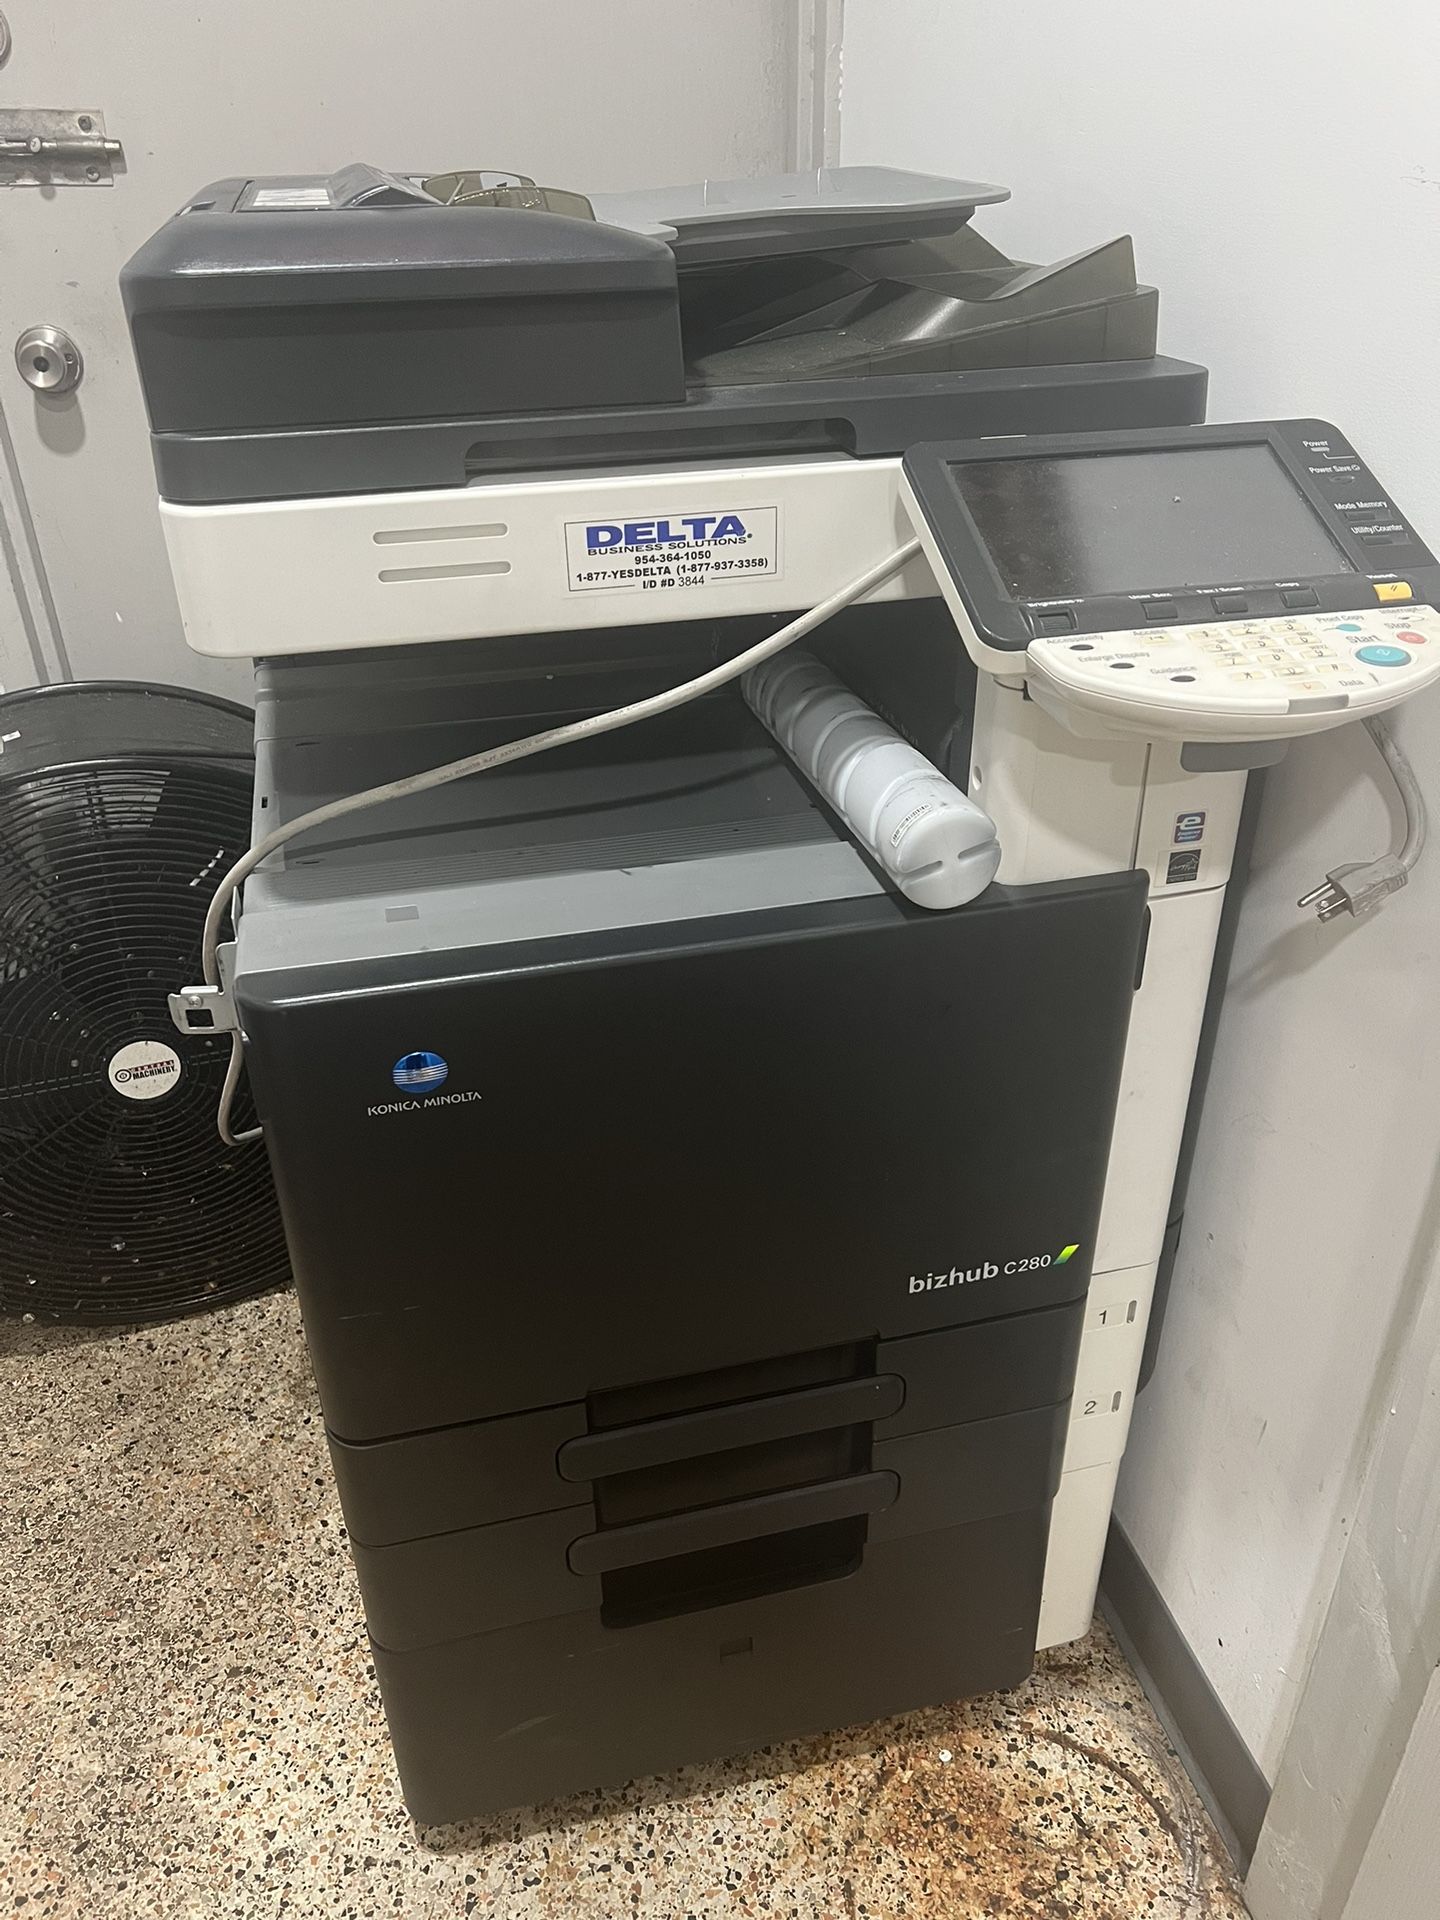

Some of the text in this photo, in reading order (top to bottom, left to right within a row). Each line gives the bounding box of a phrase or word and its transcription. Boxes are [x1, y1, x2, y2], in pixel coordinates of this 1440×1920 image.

[586, 515, 747, 548] DELTA
[587, 543, 663, 556] BUSINESS
[634, 550, 712, 565] 954-364-1050
[576, 558, 769, 582] 1-877-YESDELTA (1-877-937-3358)
[642, 575, 705, 590] I/D #D 3844
[1346, 633, 1382, 644] Start
[132, 1065, 175, 1081] MACHINERY
[367, 1091, 482, 1116] KONICA MINOLTA
[908, 1254, 1051, 1294] bizhub C280
[1099, 1310, 1108, 1325] 1
[1084, 1400, 1097, 1415] 2
